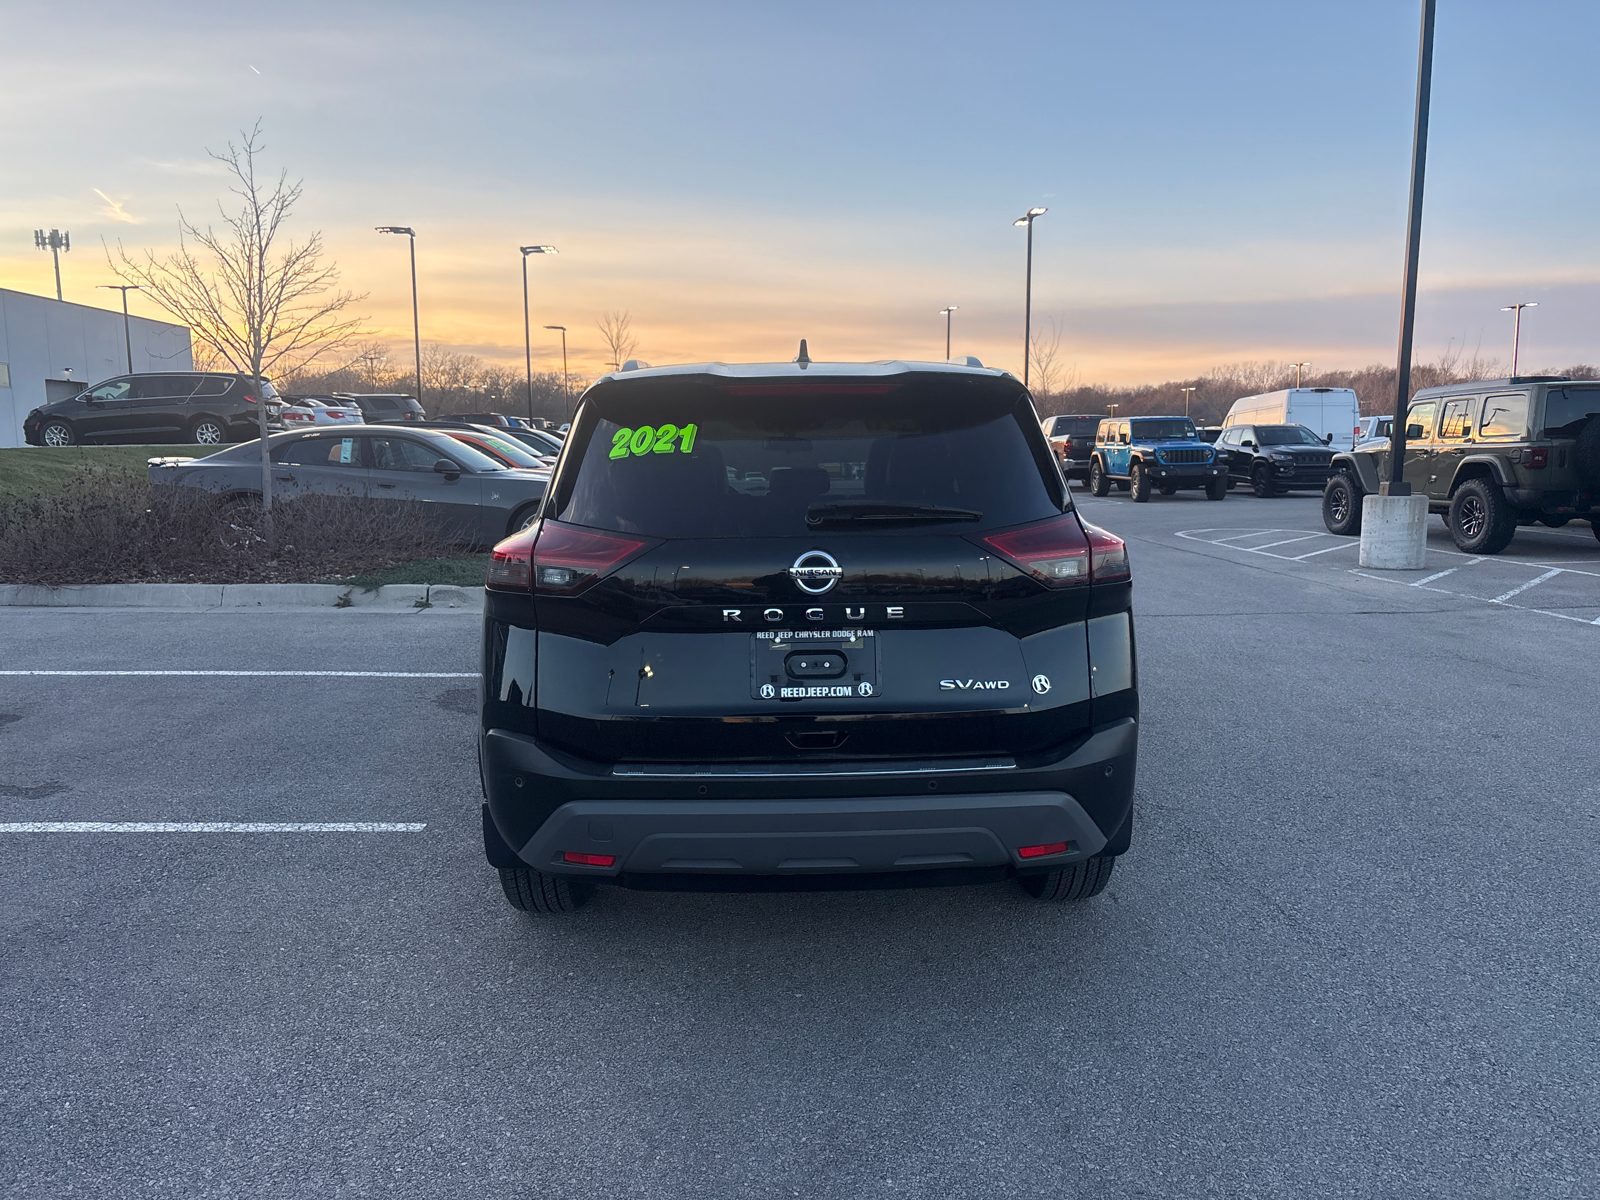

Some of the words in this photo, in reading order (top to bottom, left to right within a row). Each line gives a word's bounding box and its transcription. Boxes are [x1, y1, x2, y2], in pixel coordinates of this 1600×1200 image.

[609, 423, 698, 460] 2021
[795, 569, 837, 577] NISSAN
[722, 606, 905, 622] ROGUE
[756, 631, 775, 639] REED
[777, 631, 793, 639] JEEP
[795, 630, 831, 638] CHRYSLER
[832, 630, 855, 638] DODGE
[857, 629, 874, 637] RAM
[939, 679, 973, 690] SV
[973, 680, 1010, 690] AWD
[780, 686, 852, 698] REEDJEEP.COM
